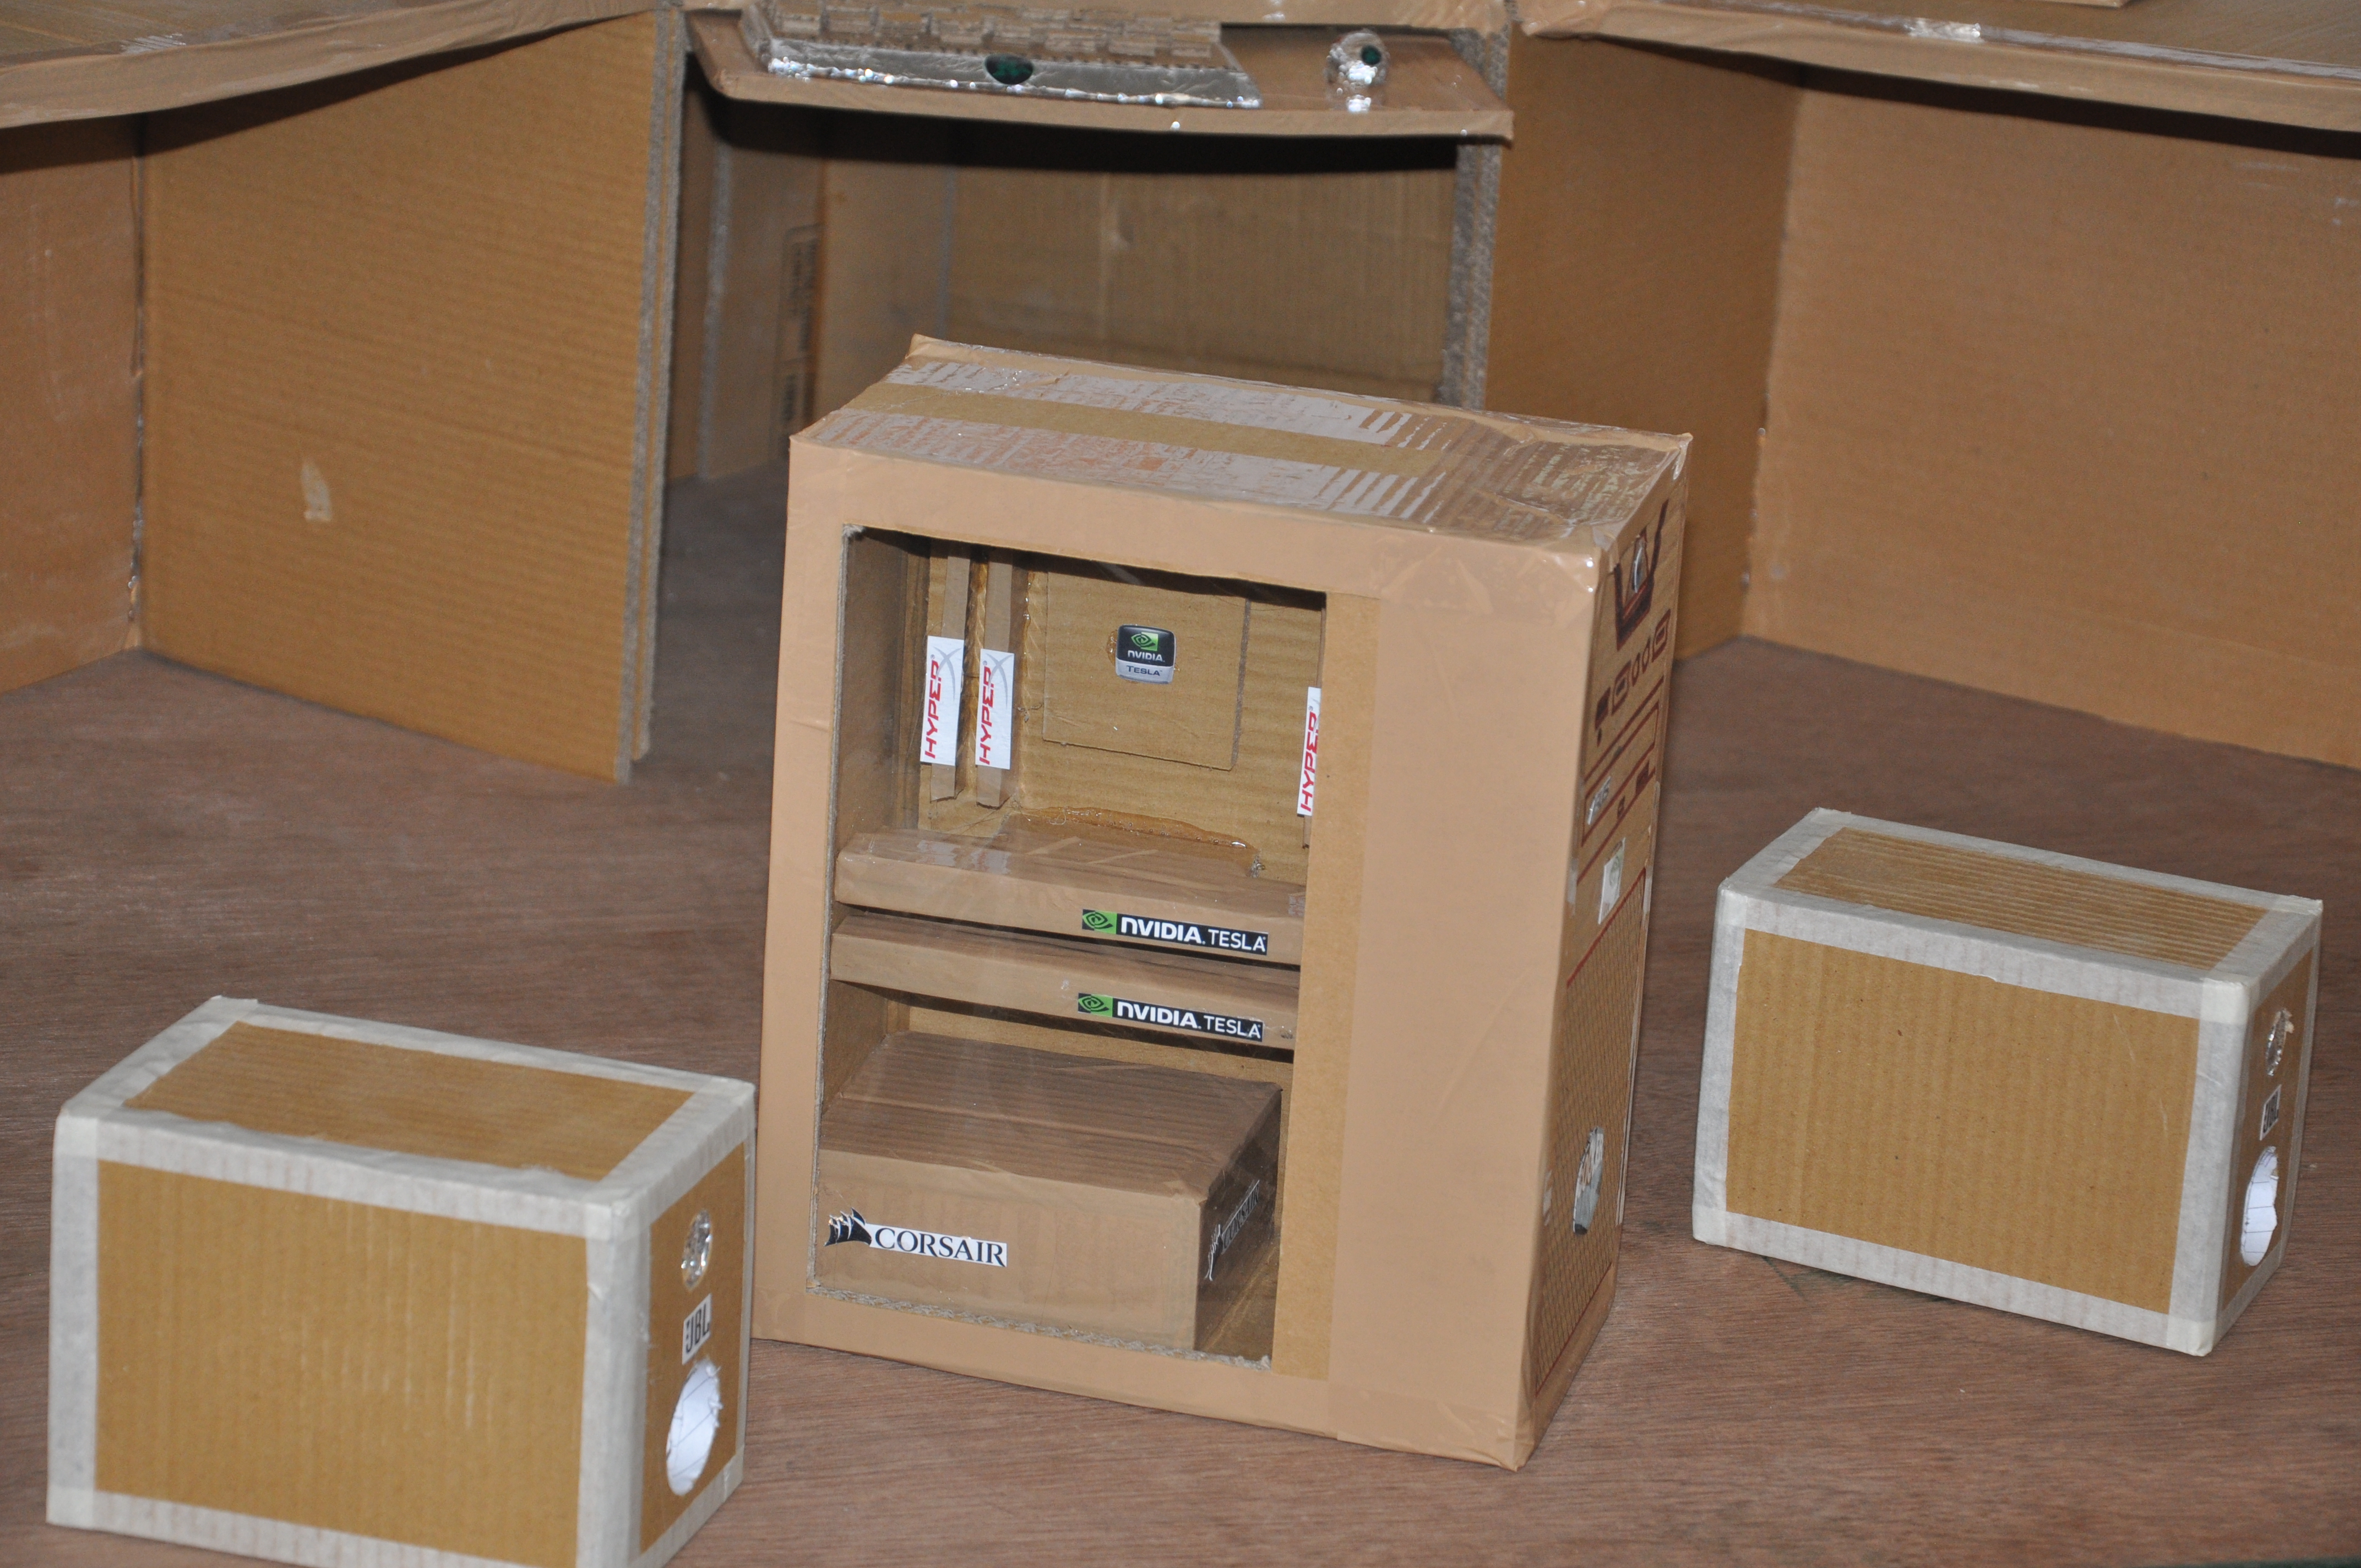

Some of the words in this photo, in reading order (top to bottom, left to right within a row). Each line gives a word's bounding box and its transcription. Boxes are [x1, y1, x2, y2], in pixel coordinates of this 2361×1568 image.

[1207, 928, 1266, 952] TESLA
[1203, 1014, 1261, 1039] TESLA
[875, 1227, 1007, 1267] CORSAIR
[686, 1303, 710, 1353] JBL
